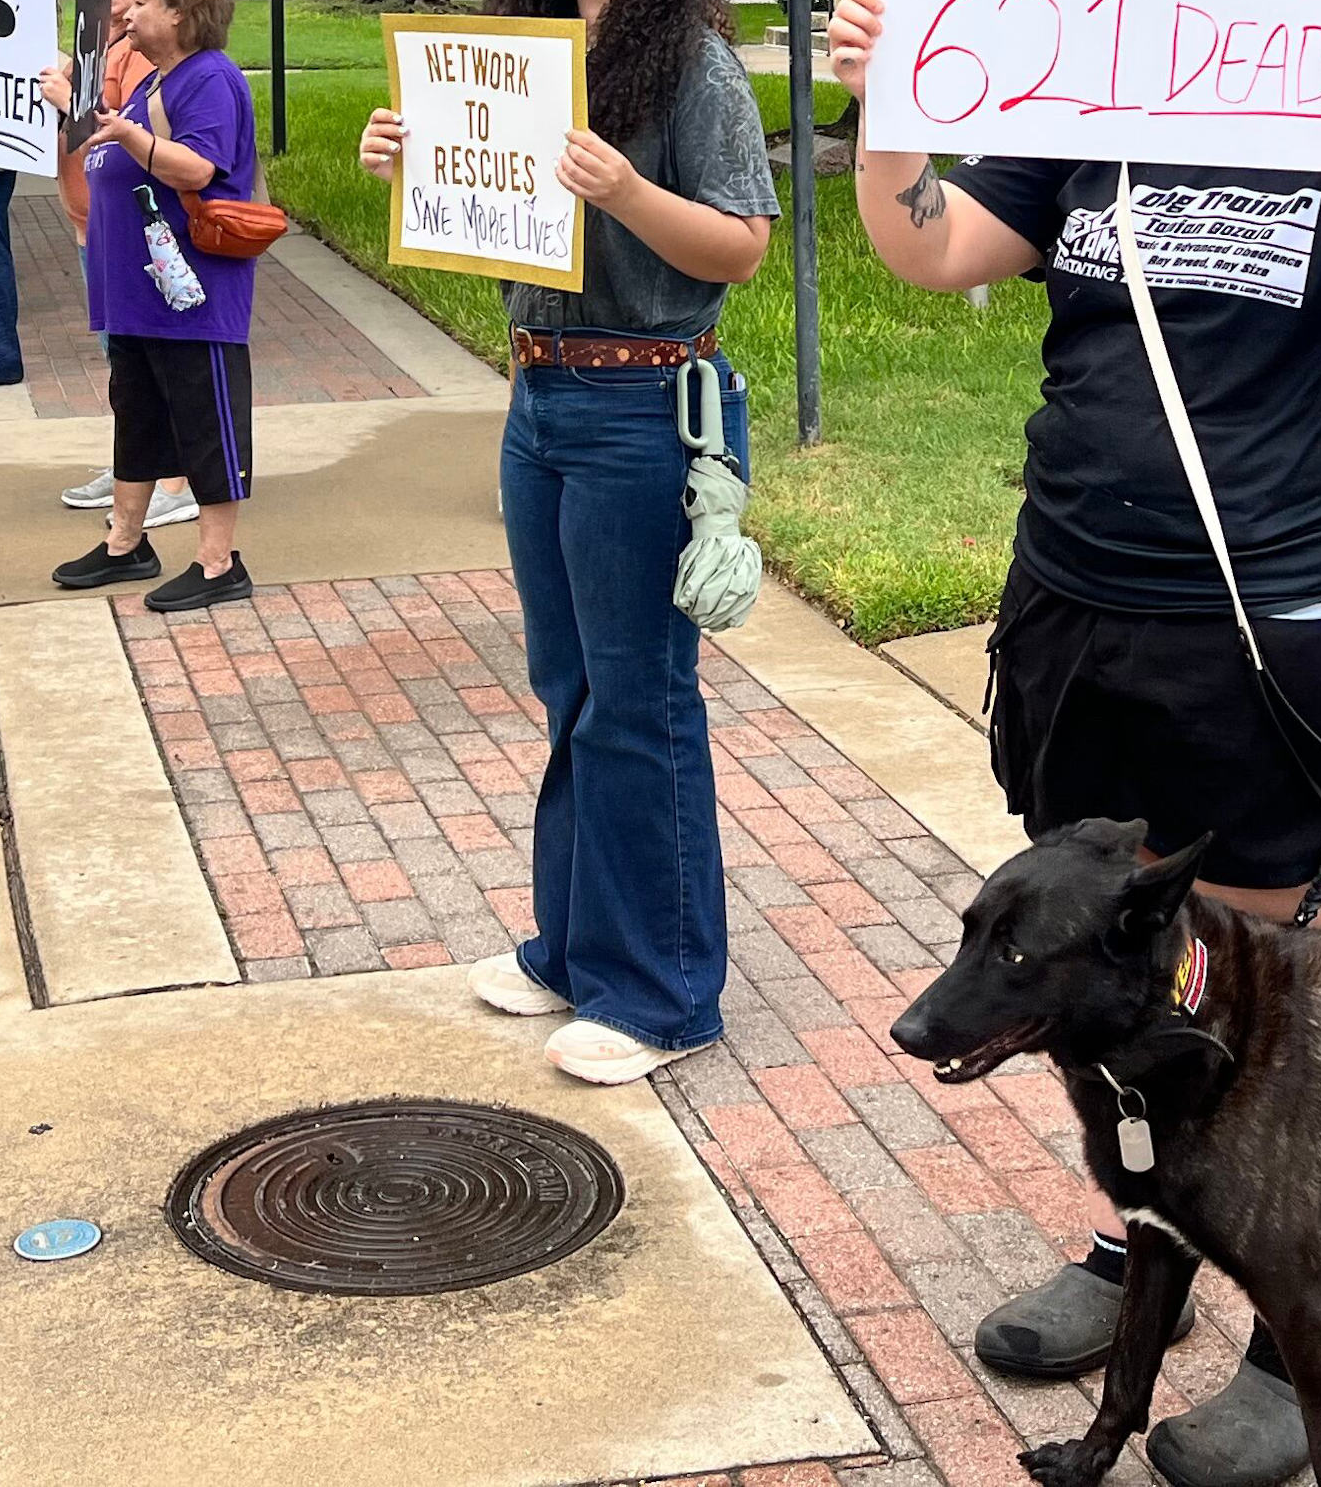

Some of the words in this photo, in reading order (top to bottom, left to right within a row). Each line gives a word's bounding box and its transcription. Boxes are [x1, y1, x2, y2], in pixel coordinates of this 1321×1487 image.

[425, 42, 530, 98] NETWORK
[465, 100, 490, 142] TO
[434, 145, 536, 195] RESCUES
[405, 186, 453, 236] SAVE
[461, 193, 510, 250] MORE
[1197, 191, 1314, 217] Trainer
[1147, 255, 1172, 268] Any
[1212, 259, 1240, 273] Any
[1240, 263, 1270, 277] Size
[1233, 247, 1303, 268] Obedience
